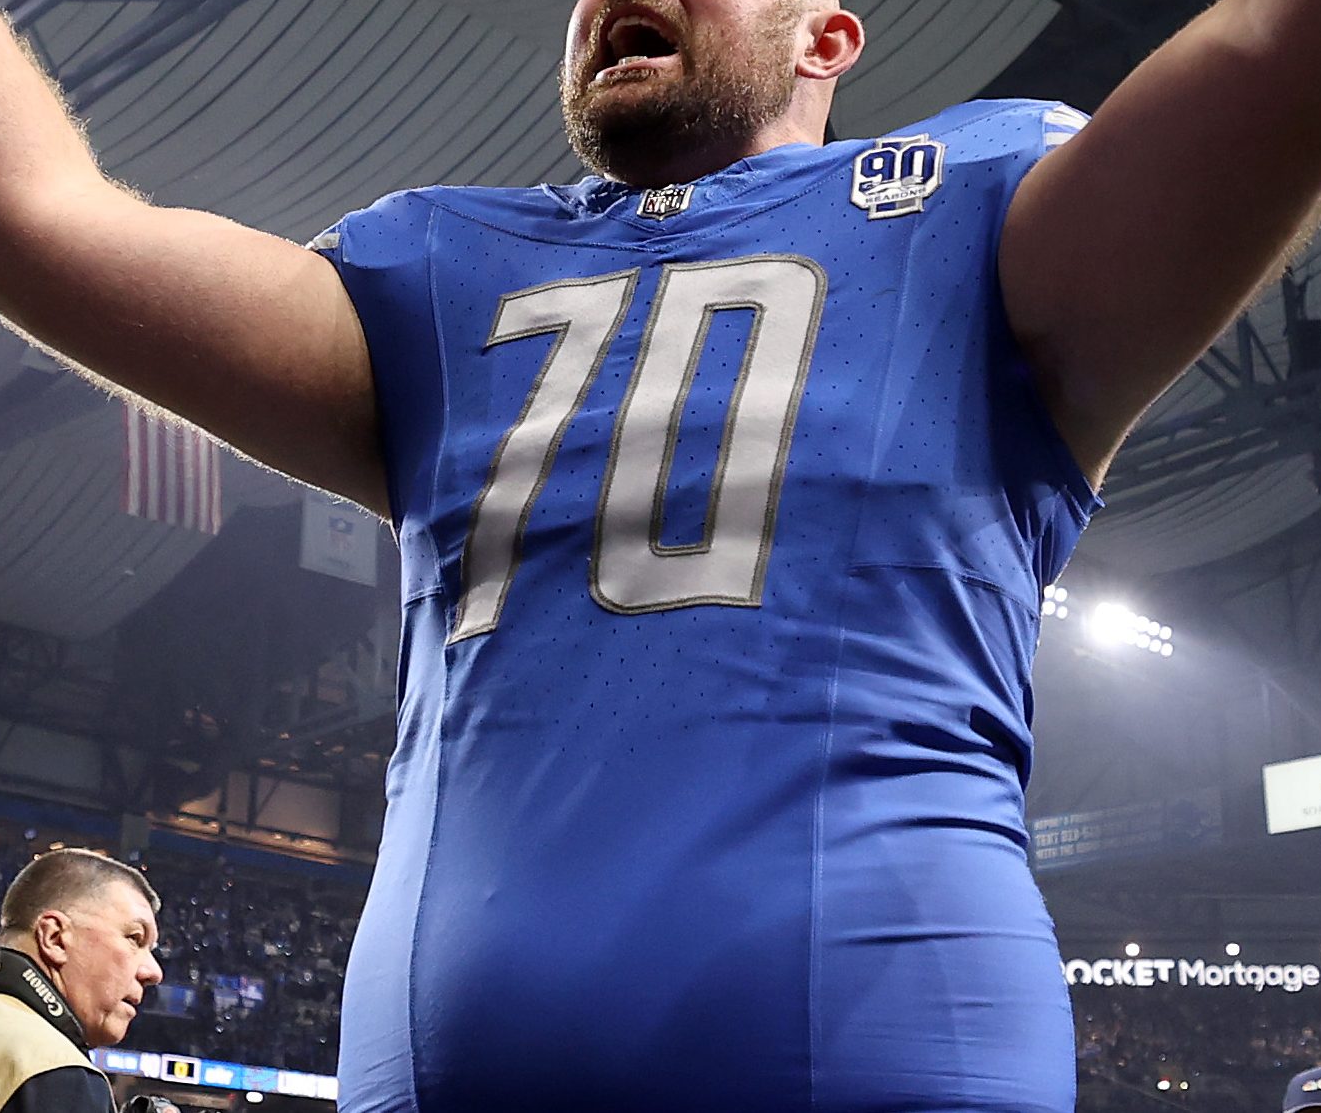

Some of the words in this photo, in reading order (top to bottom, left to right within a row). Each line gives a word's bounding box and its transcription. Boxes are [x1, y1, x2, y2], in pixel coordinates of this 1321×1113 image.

[860, 144, 937, 185] 90
[865, 187, 926, 205] SEASONS
[447, 252, 828, 644] 70
[22, 968, 64, 1017] Canon
[1060, 958, 1175, 986] OCKET
[1178, 958, 1321, 991] Mortgage
